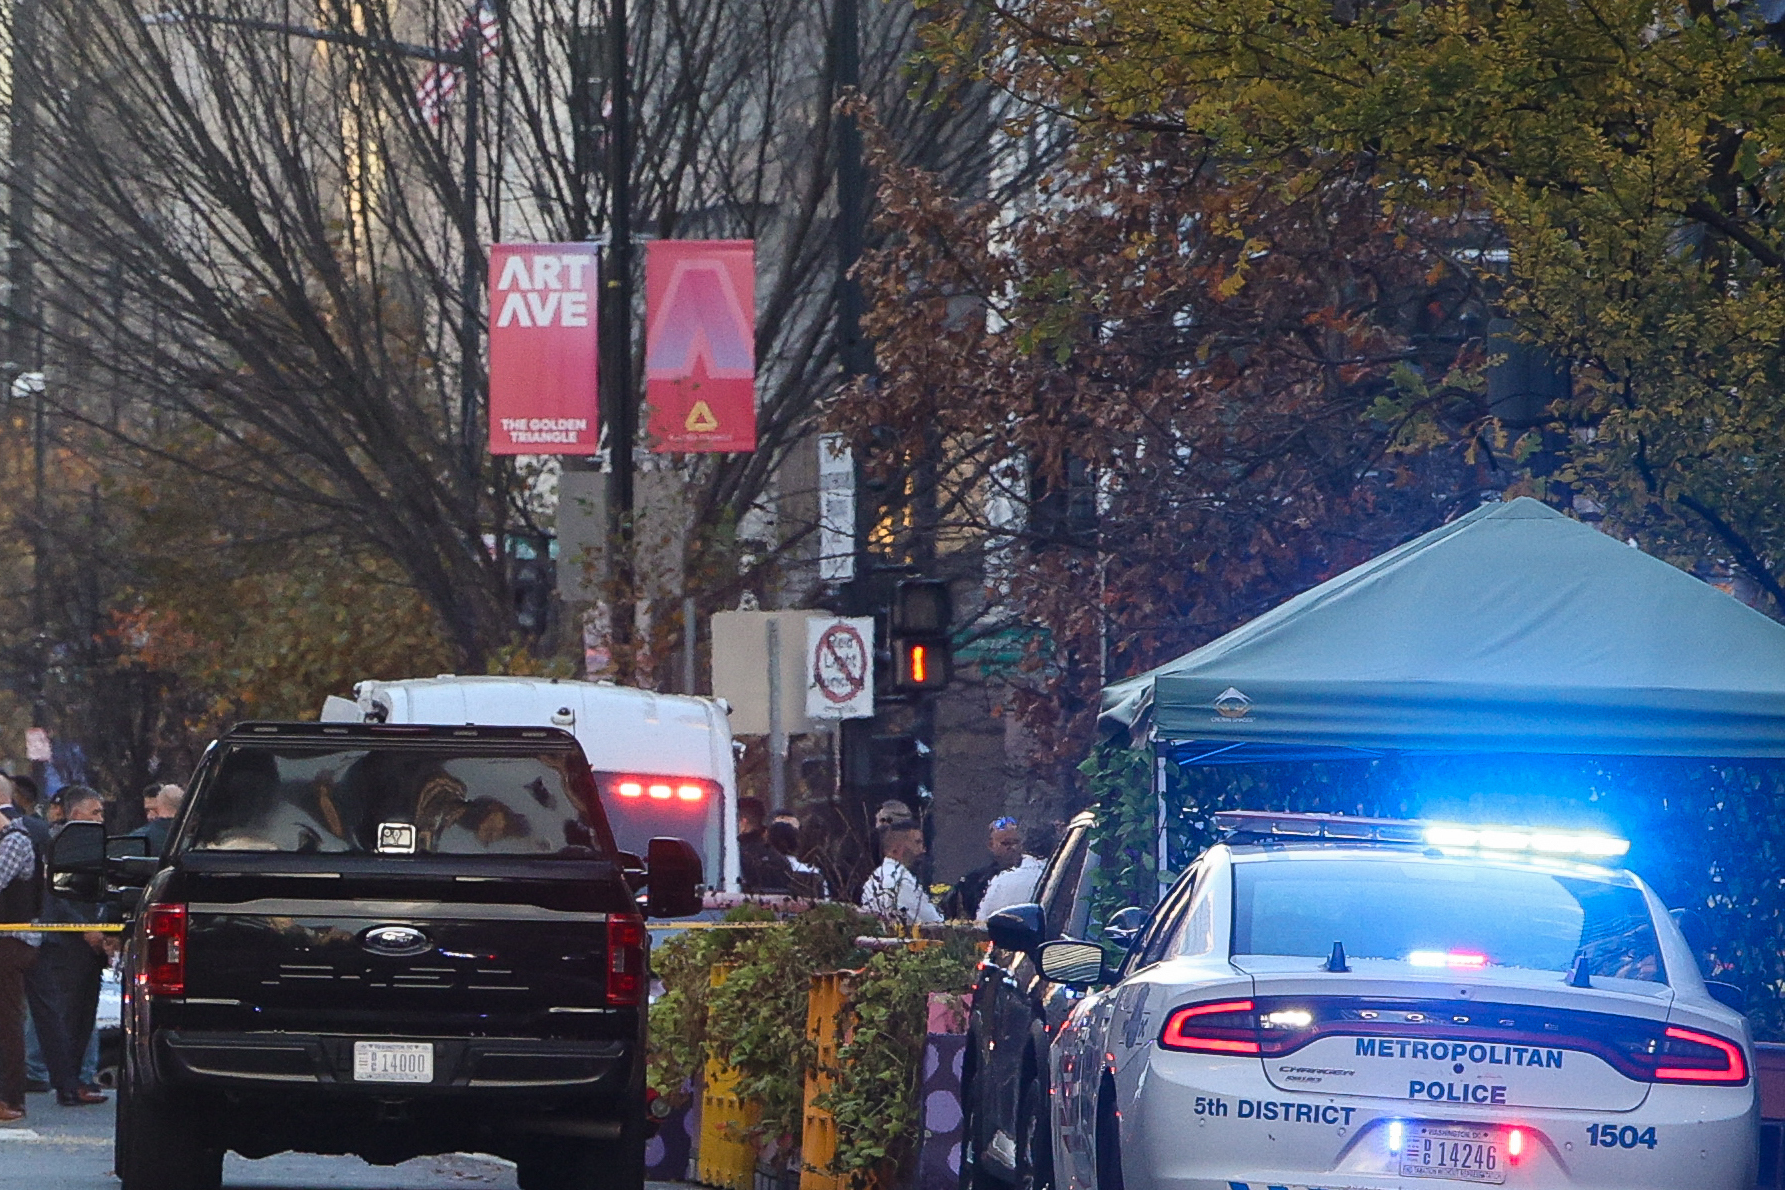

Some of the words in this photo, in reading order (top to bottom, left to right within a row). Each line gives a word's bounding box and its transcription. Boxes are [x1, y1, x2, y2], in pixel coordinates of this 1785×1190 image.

[498, 255, 590, 290] ART
[496, 291, 589, 327] AVE
[501, 418, 528, 430] THE
[529, 418, 587, 431] GOLDEN
[510, 431, 578, 443] TRIANGLE
[381, 1053, 425, 1072] 14000
[1355, 1038, 1563, 1069] METROPOLITAN
[1279, 1065, 1355, 1077] CHARGER
[1408, 1080, 1507, 1104] POLICE
[1193, 1096, 1228, 1117] 5th
[1237, 1099, 1356, 1126] DISTRICT
[1585, 1123, 1658, 1149] 1504
[1437, 1141, 1497, 1171] 14246
